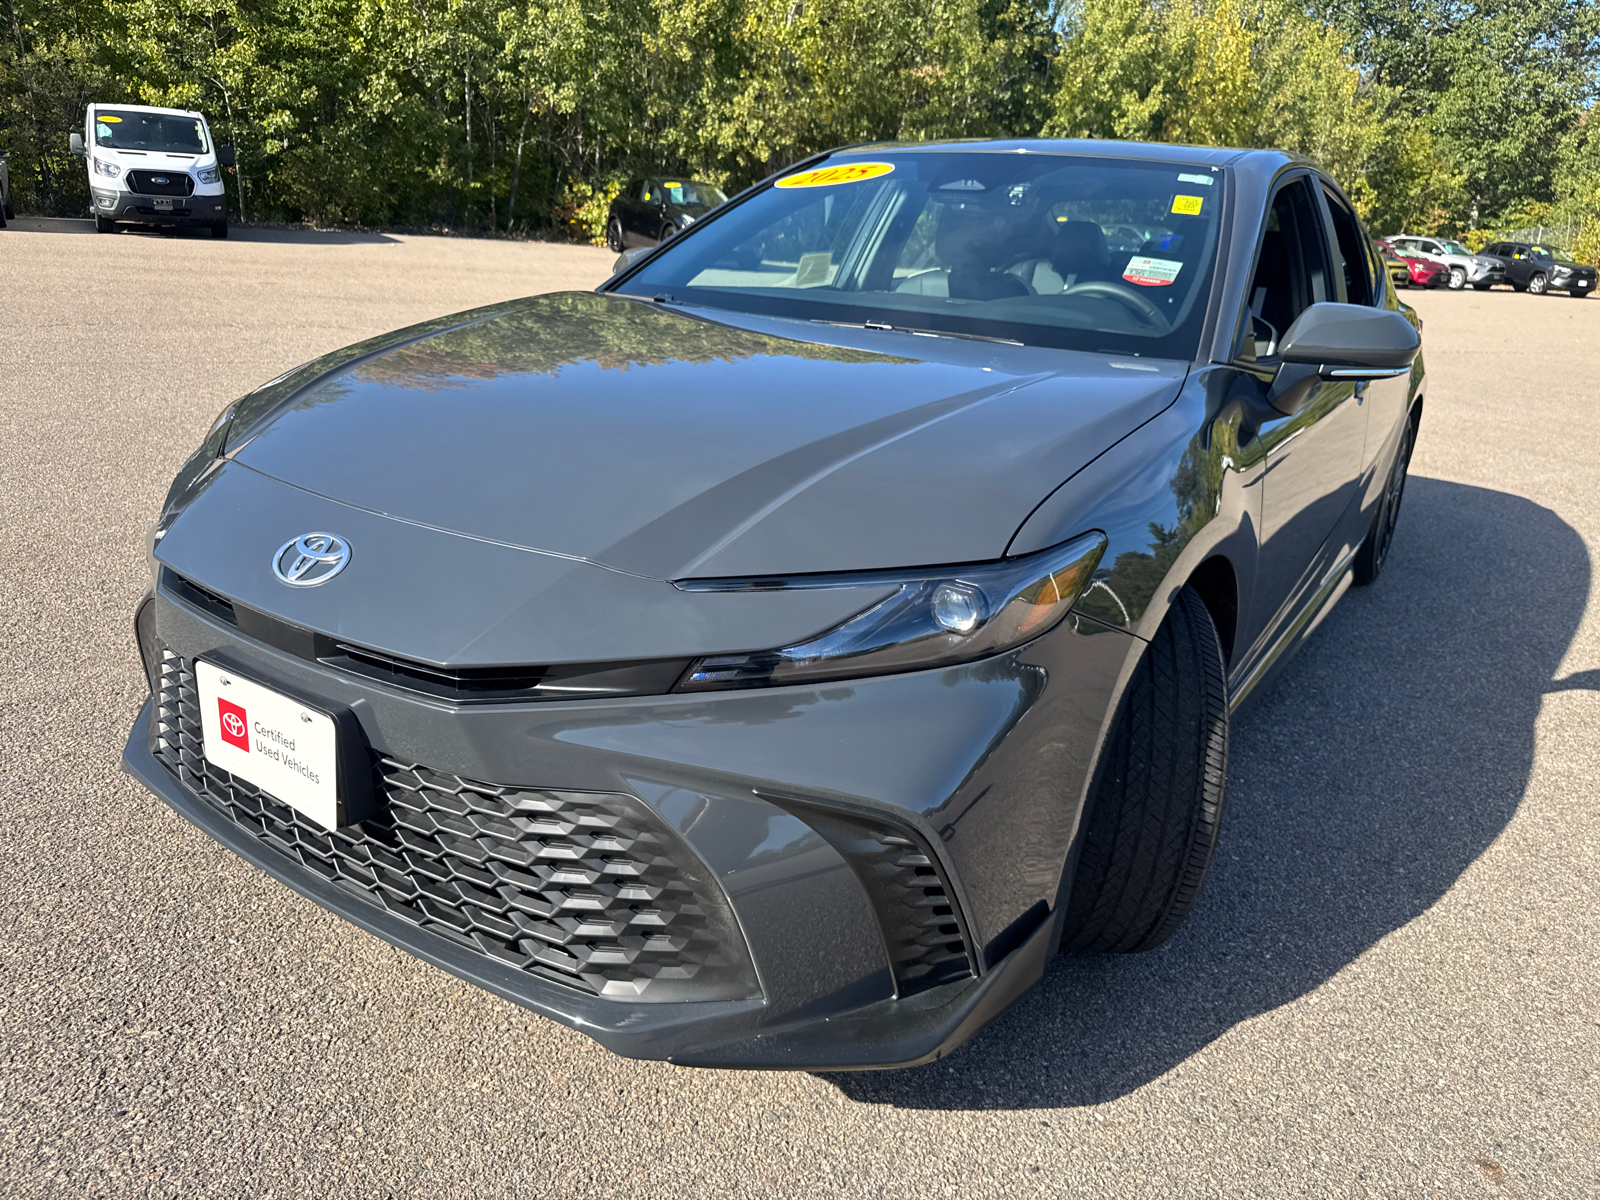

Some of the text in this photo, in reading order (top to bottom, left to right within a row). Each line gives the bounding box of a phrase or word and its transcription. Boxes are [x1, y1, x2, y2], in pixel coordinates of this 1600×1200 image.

[789, 166, 878, 185] 2025
[254, 721, 296, 751] Certified
[256, 739, 320, 784] Used Vehicles
